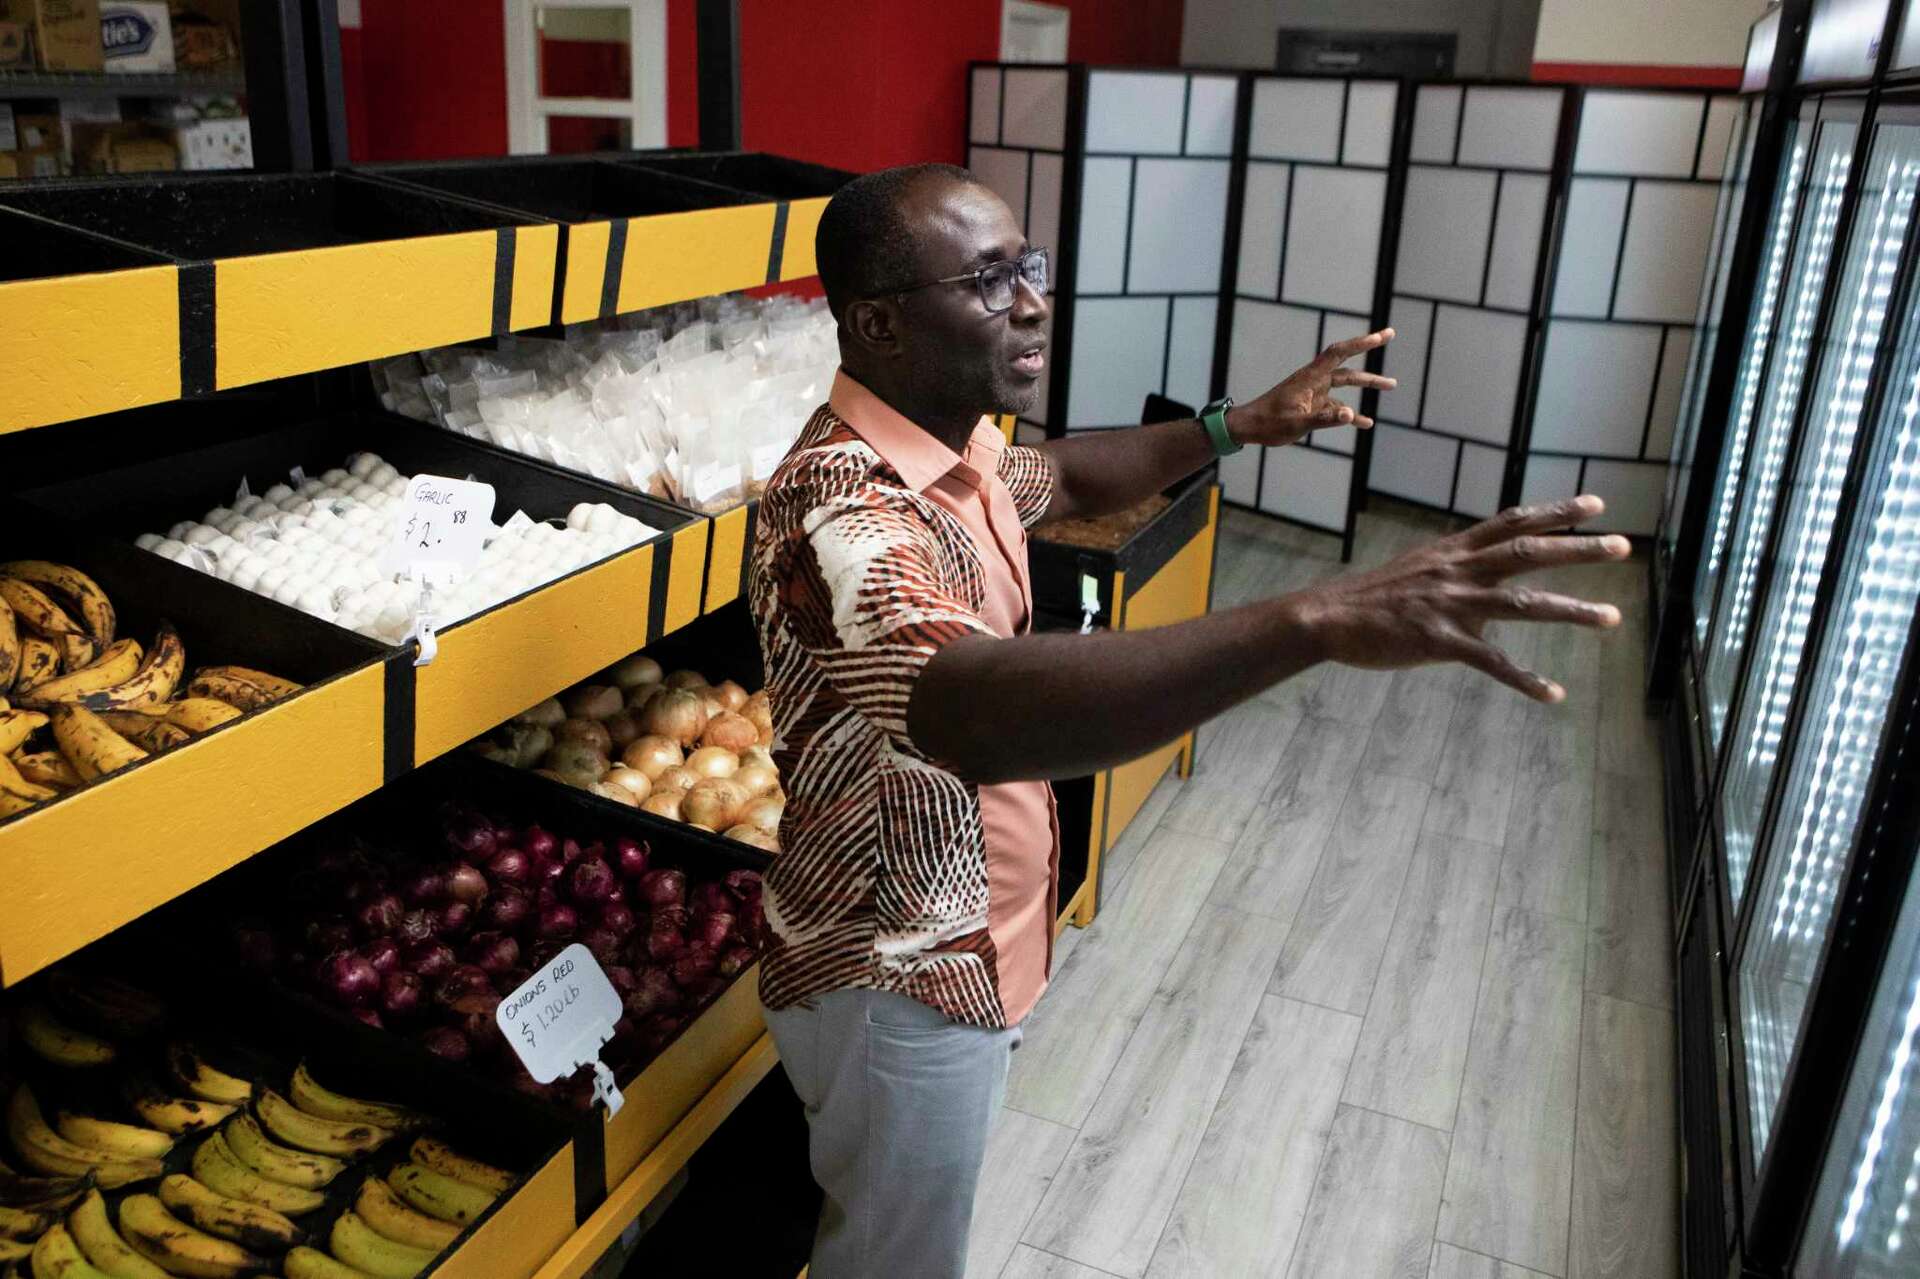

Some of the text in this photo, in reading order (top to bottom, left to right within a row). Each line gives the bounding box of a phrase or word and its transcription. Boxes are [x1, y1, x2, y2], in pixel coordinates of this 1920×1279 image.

[414, 482, 454, 505] GARLIC
[505, 959, 575, 1020] ONIONS RED
